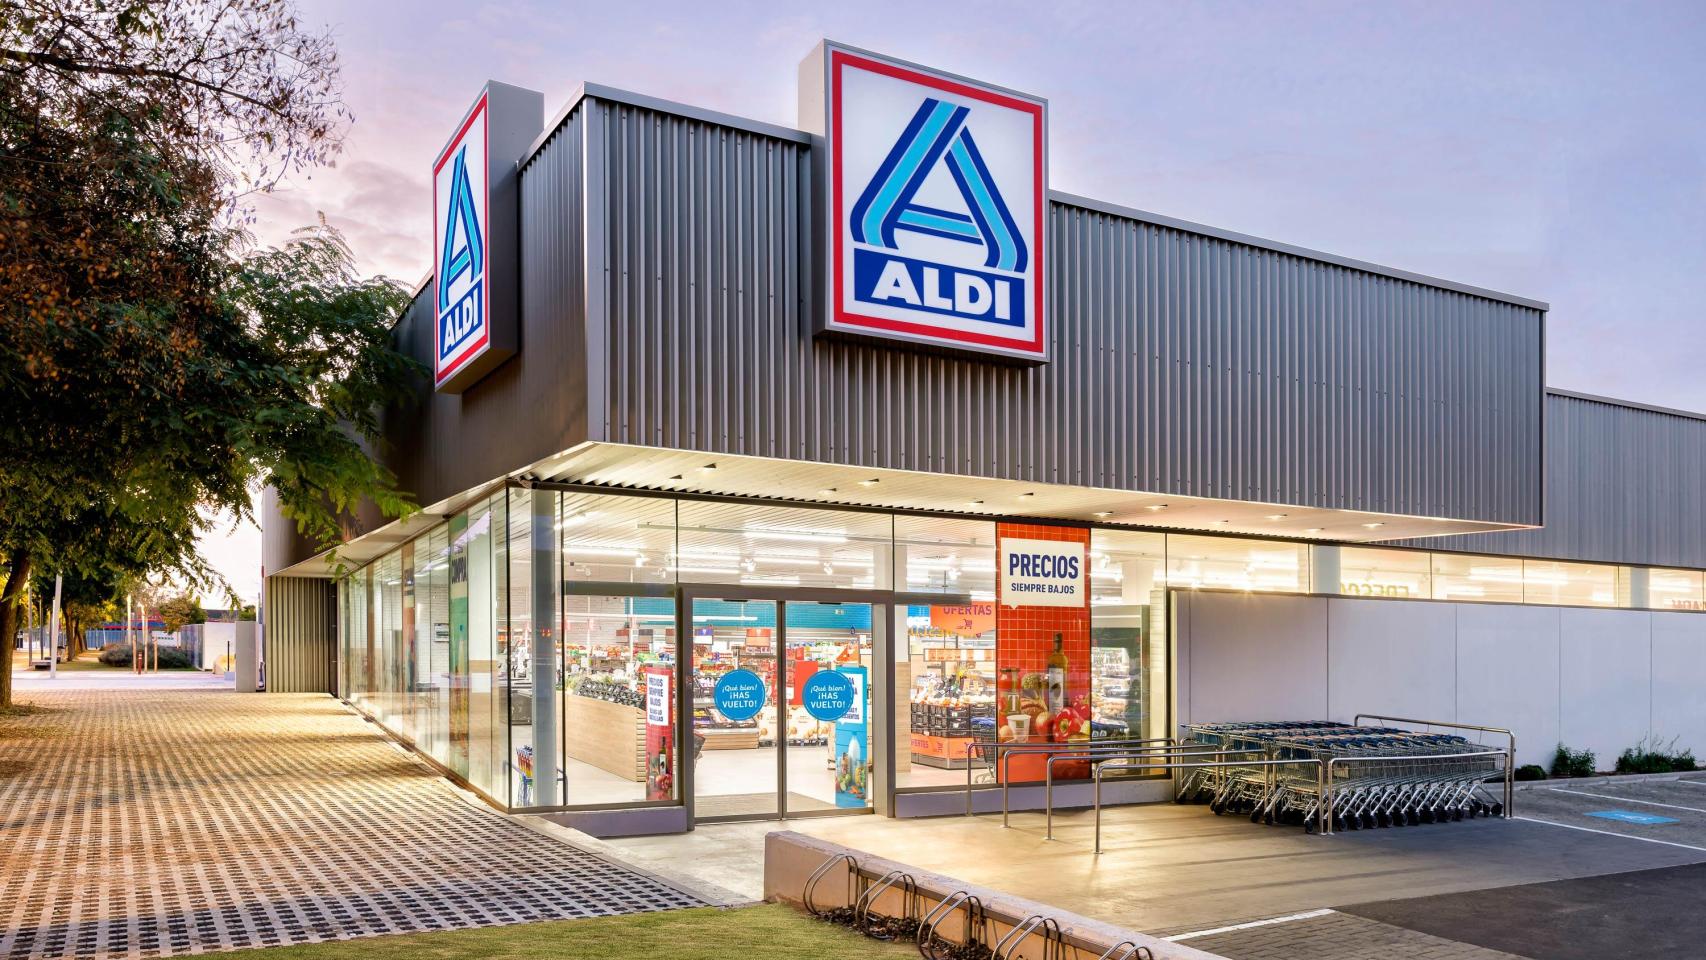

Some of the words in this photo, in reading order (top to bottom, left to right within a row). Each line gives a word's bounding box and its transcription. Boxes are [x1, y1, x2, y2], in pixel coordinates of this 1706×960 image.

[871, 259, 1011, 321] ALDI
[443, 287, 479, 354] ALDI
[1009, 553, 1079, 580] PRECIOS
[1011, 582, 1046, 593] SIEMPRE
[1047, 584, 1075, 594] BAJOS
[729, 691, 750, 699] ¡HAS
[818, 692, 839, 700] ¡HAS
[722, 700, 757, 708] VUELTO!
[810, 700, 846, 709] VUELTO!
